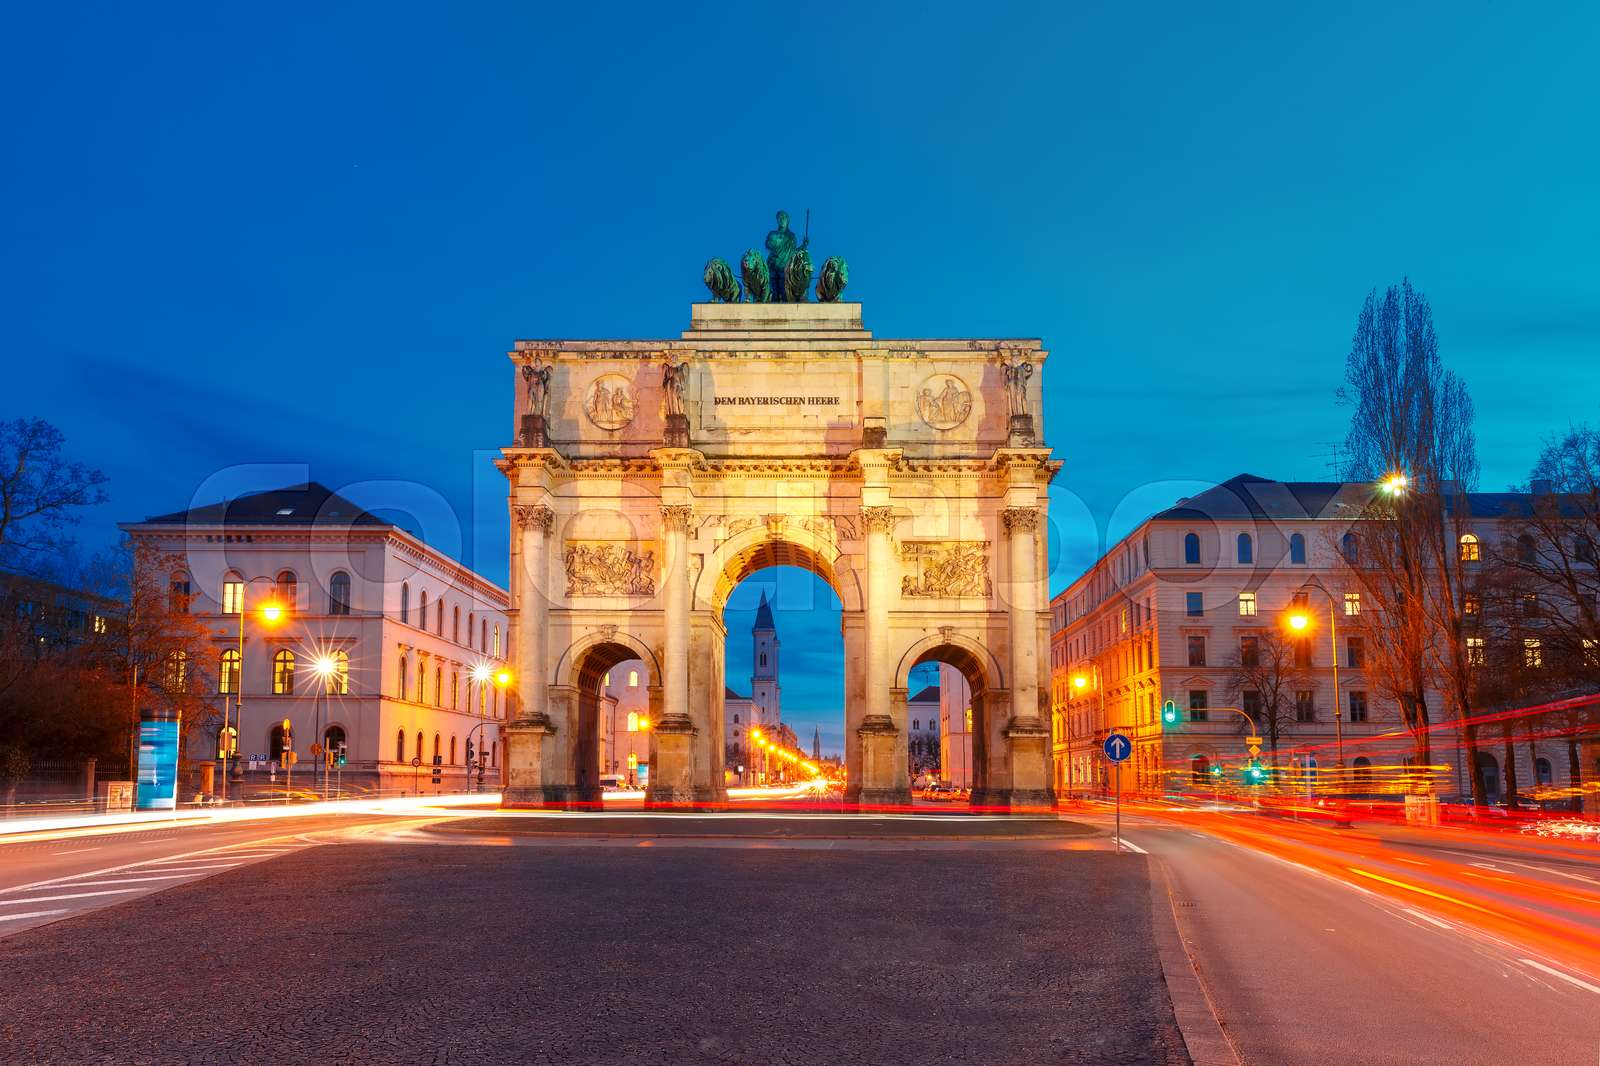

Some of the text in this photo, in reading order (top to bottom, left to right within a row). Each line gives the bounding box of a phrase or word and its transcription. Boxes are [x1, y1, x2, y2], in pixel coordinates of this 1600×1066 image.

[714, 396, 840, 406] DEM BAYERISCHEN HEERE
